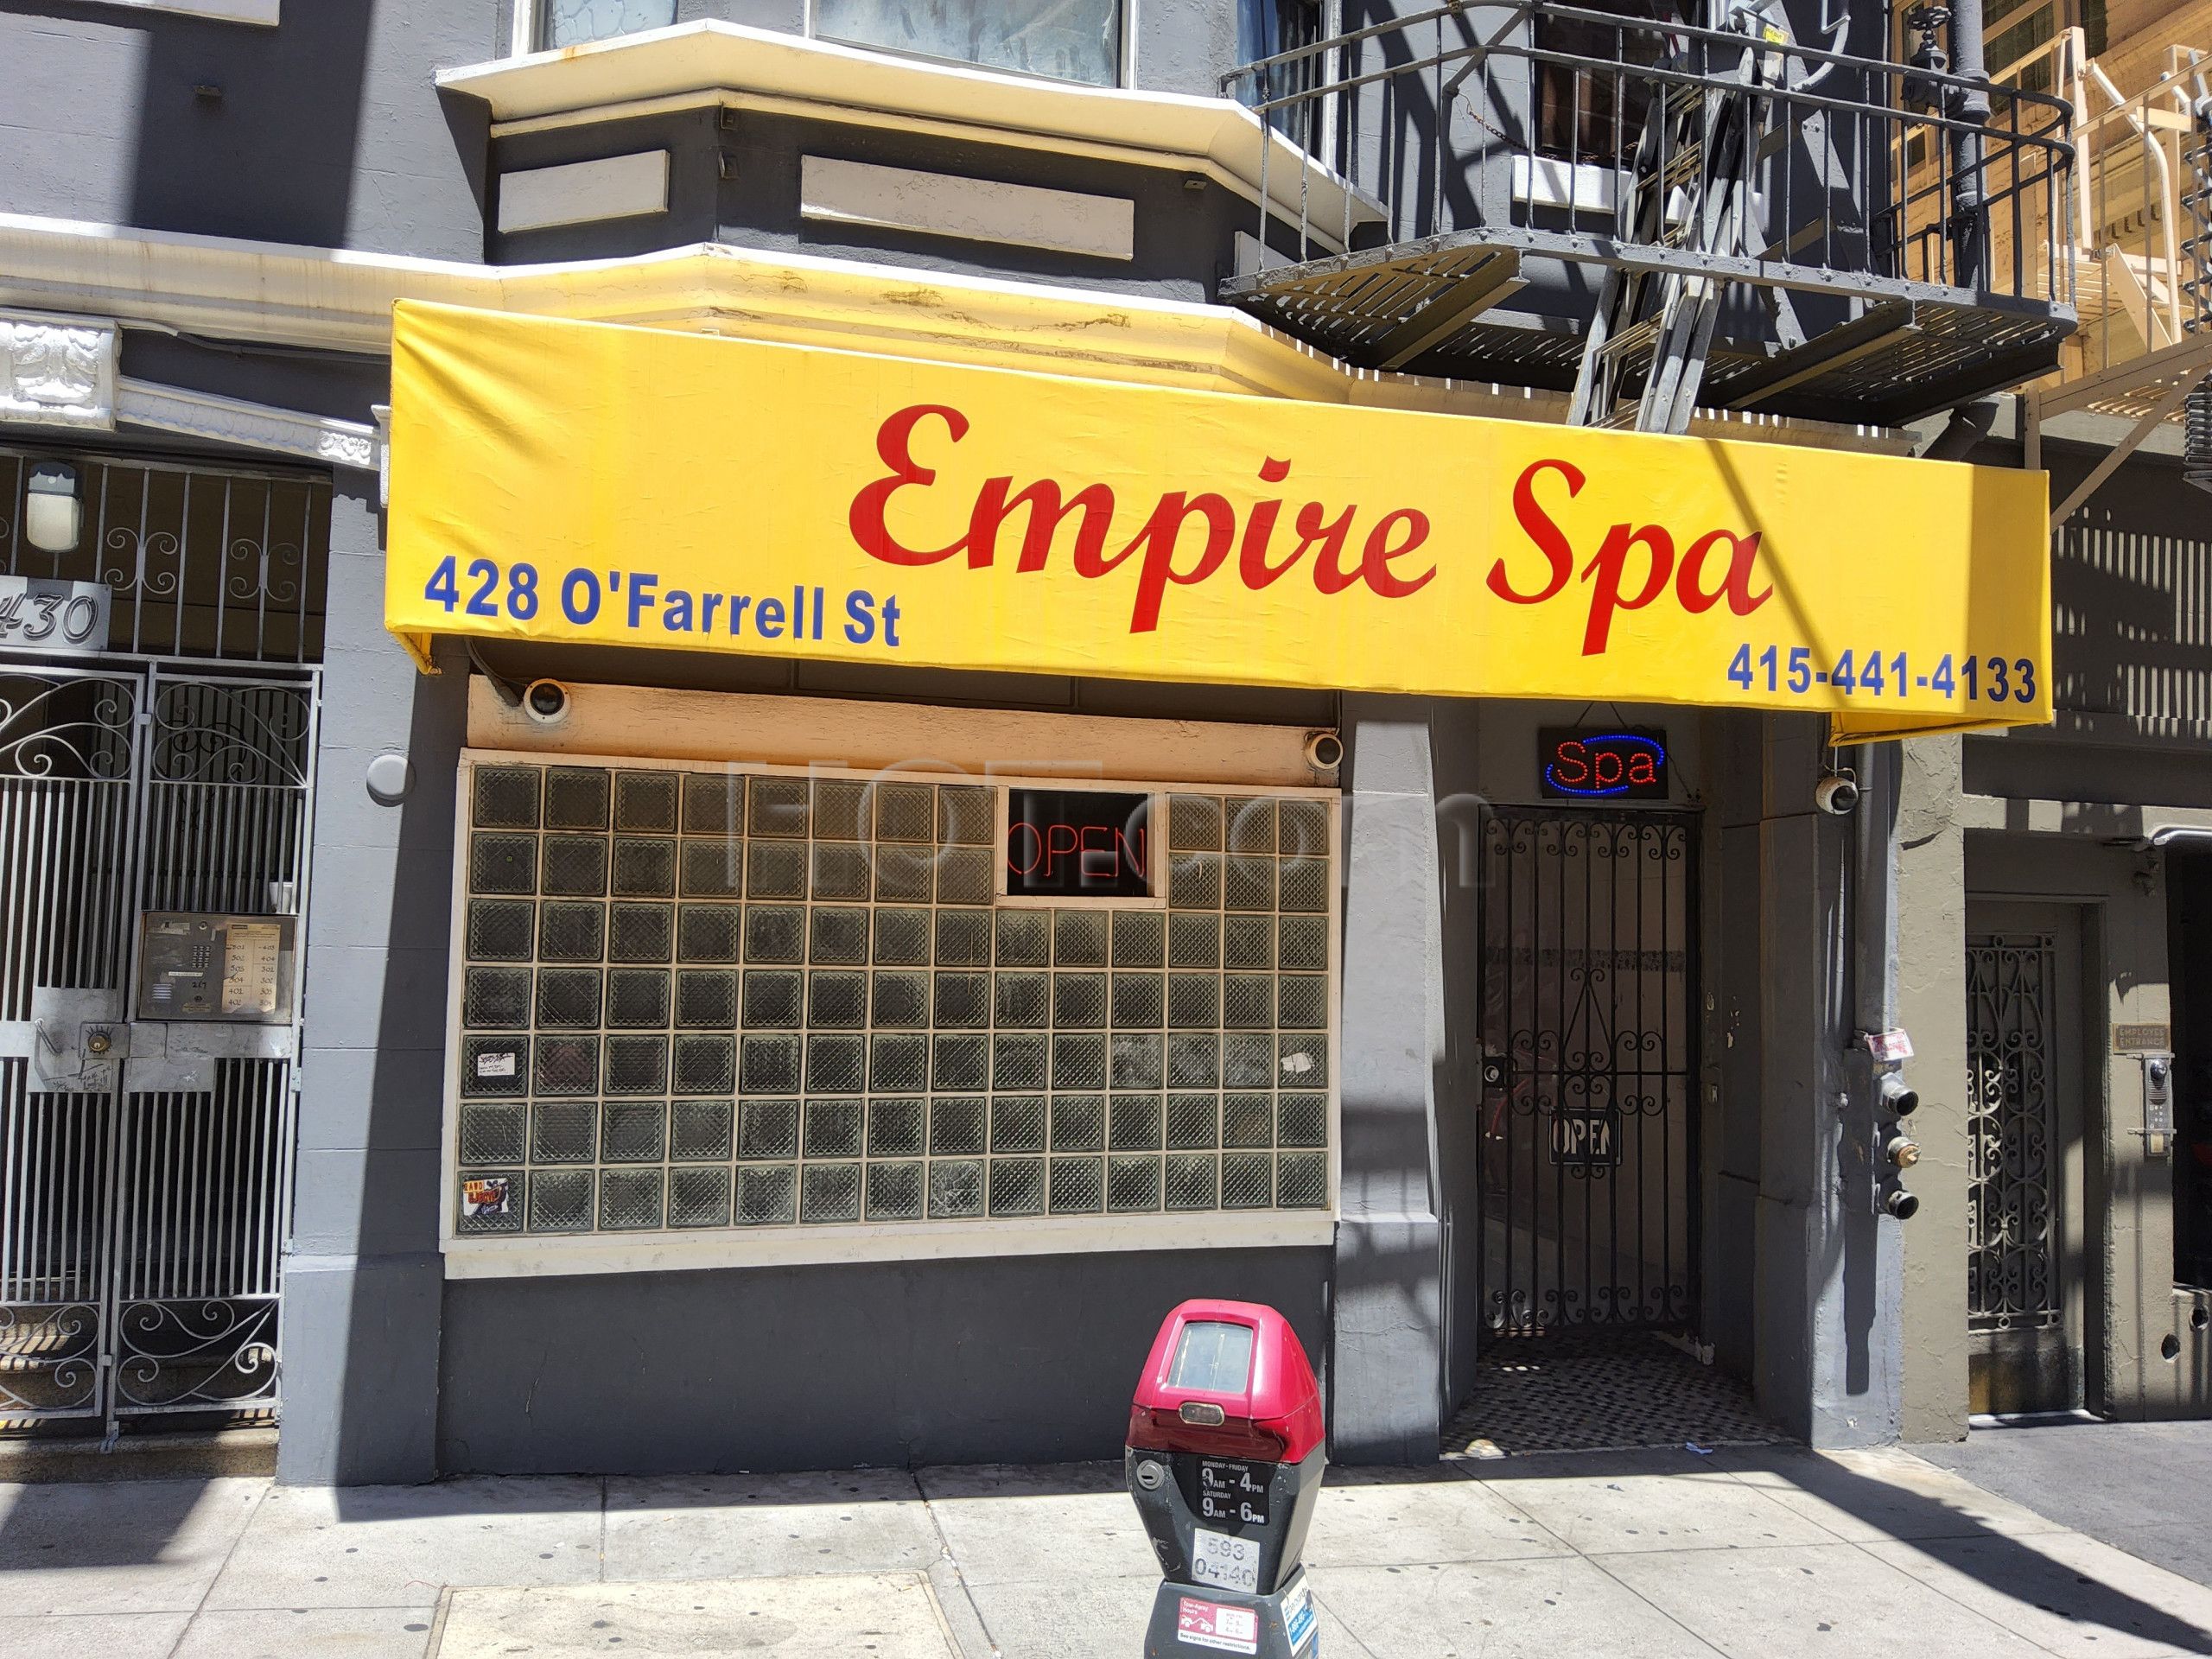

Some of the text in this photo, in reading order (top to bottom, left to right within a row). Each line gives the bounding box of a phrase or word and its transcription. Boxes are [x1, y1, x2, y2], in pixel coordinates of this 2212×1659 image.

[850, 406, 1772, 656] Empire Spa
[0, 593, 99, 645] 430
[424, 556, 899, 646] 428 O'Farrell St
[1728, 645, 2036, 702] 415-441-4133
[1557, 741, 1656, 788] Spa
[1007, 822, 1146, 877] OPEN
[1553, 1118, 1615, 1154] OPEN
[1203, 1490, 1231, 1500] SATURDAY
[1240, 1472, 1263, 1494] 4PM
[1203, 1497, 1225, 1518] 9AM
[1240, 1502, 1264, 1523] 6PM
[1208, 1537, 1245, 1561] 593
[1183, 1600, 1208, 1612] Tow-Away
[1183, 1606, 1198, 1615] Hours
